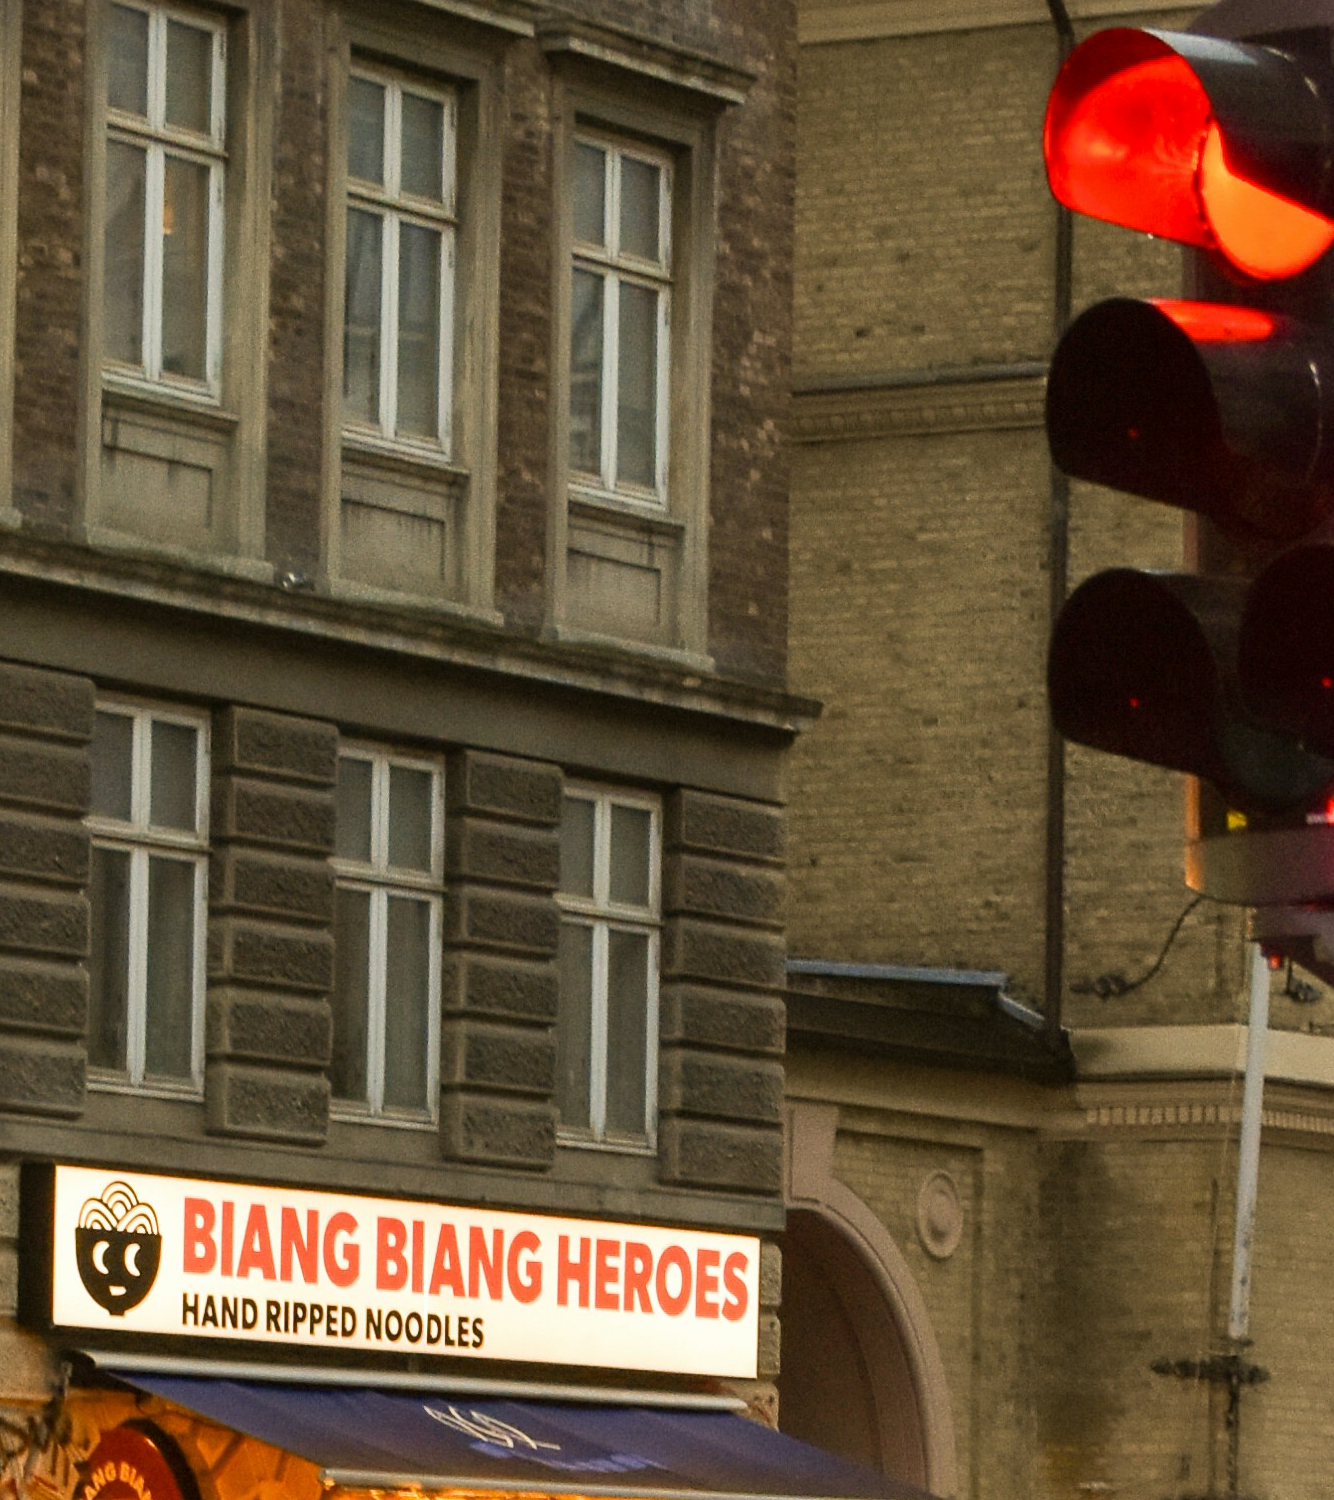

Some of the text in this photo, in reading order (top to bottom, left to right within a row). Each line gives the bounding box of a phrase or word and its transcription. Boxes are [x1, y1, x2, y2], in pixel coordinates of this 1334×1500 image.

[182, 1196, 750, 1323] BIANG BIANG HEROES
[181, 1293, 485, 1349] HAND RIPPED NOODLES
